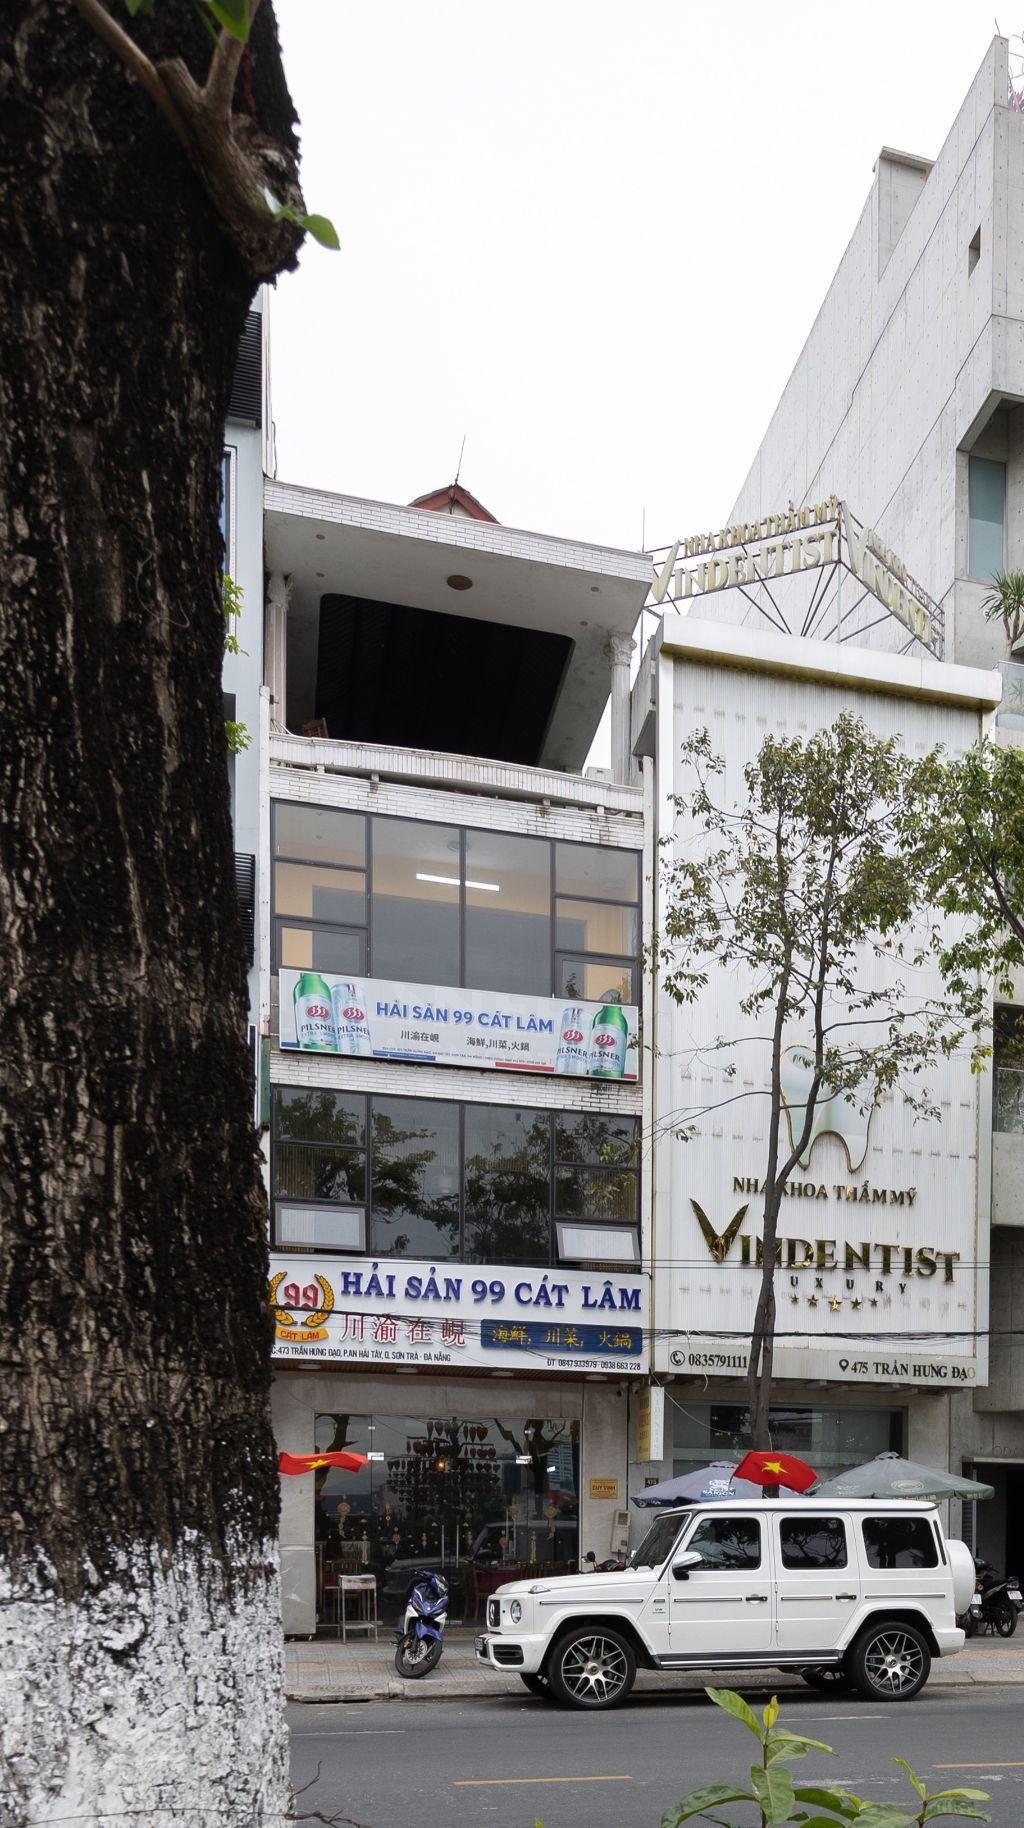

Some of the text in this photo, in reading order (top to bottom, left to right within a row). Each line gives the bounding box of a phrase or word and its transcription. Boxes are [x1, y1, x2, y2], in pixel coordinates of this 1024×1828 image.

[650, 530, 838, 604] VINDENTIST
[376, 1000, 554, 1033] HẢI SẢN 99 CÁT LÂM
[833, 1180, 888, 1205] THẨM
[890, 1186, 918, 1206] MỸ
[690, 1198, 960, 1283] VINDENTIST
[284, 1282, 319, 1309] 99
[340, 1262, 642, 1311] HẢI SẢN 99 CÁT LÂM
[688, 1353, 747, 1369] 0835791111
[850, 1359, 976, 1382] 475 TRẦN HƯNG ĐẠO
